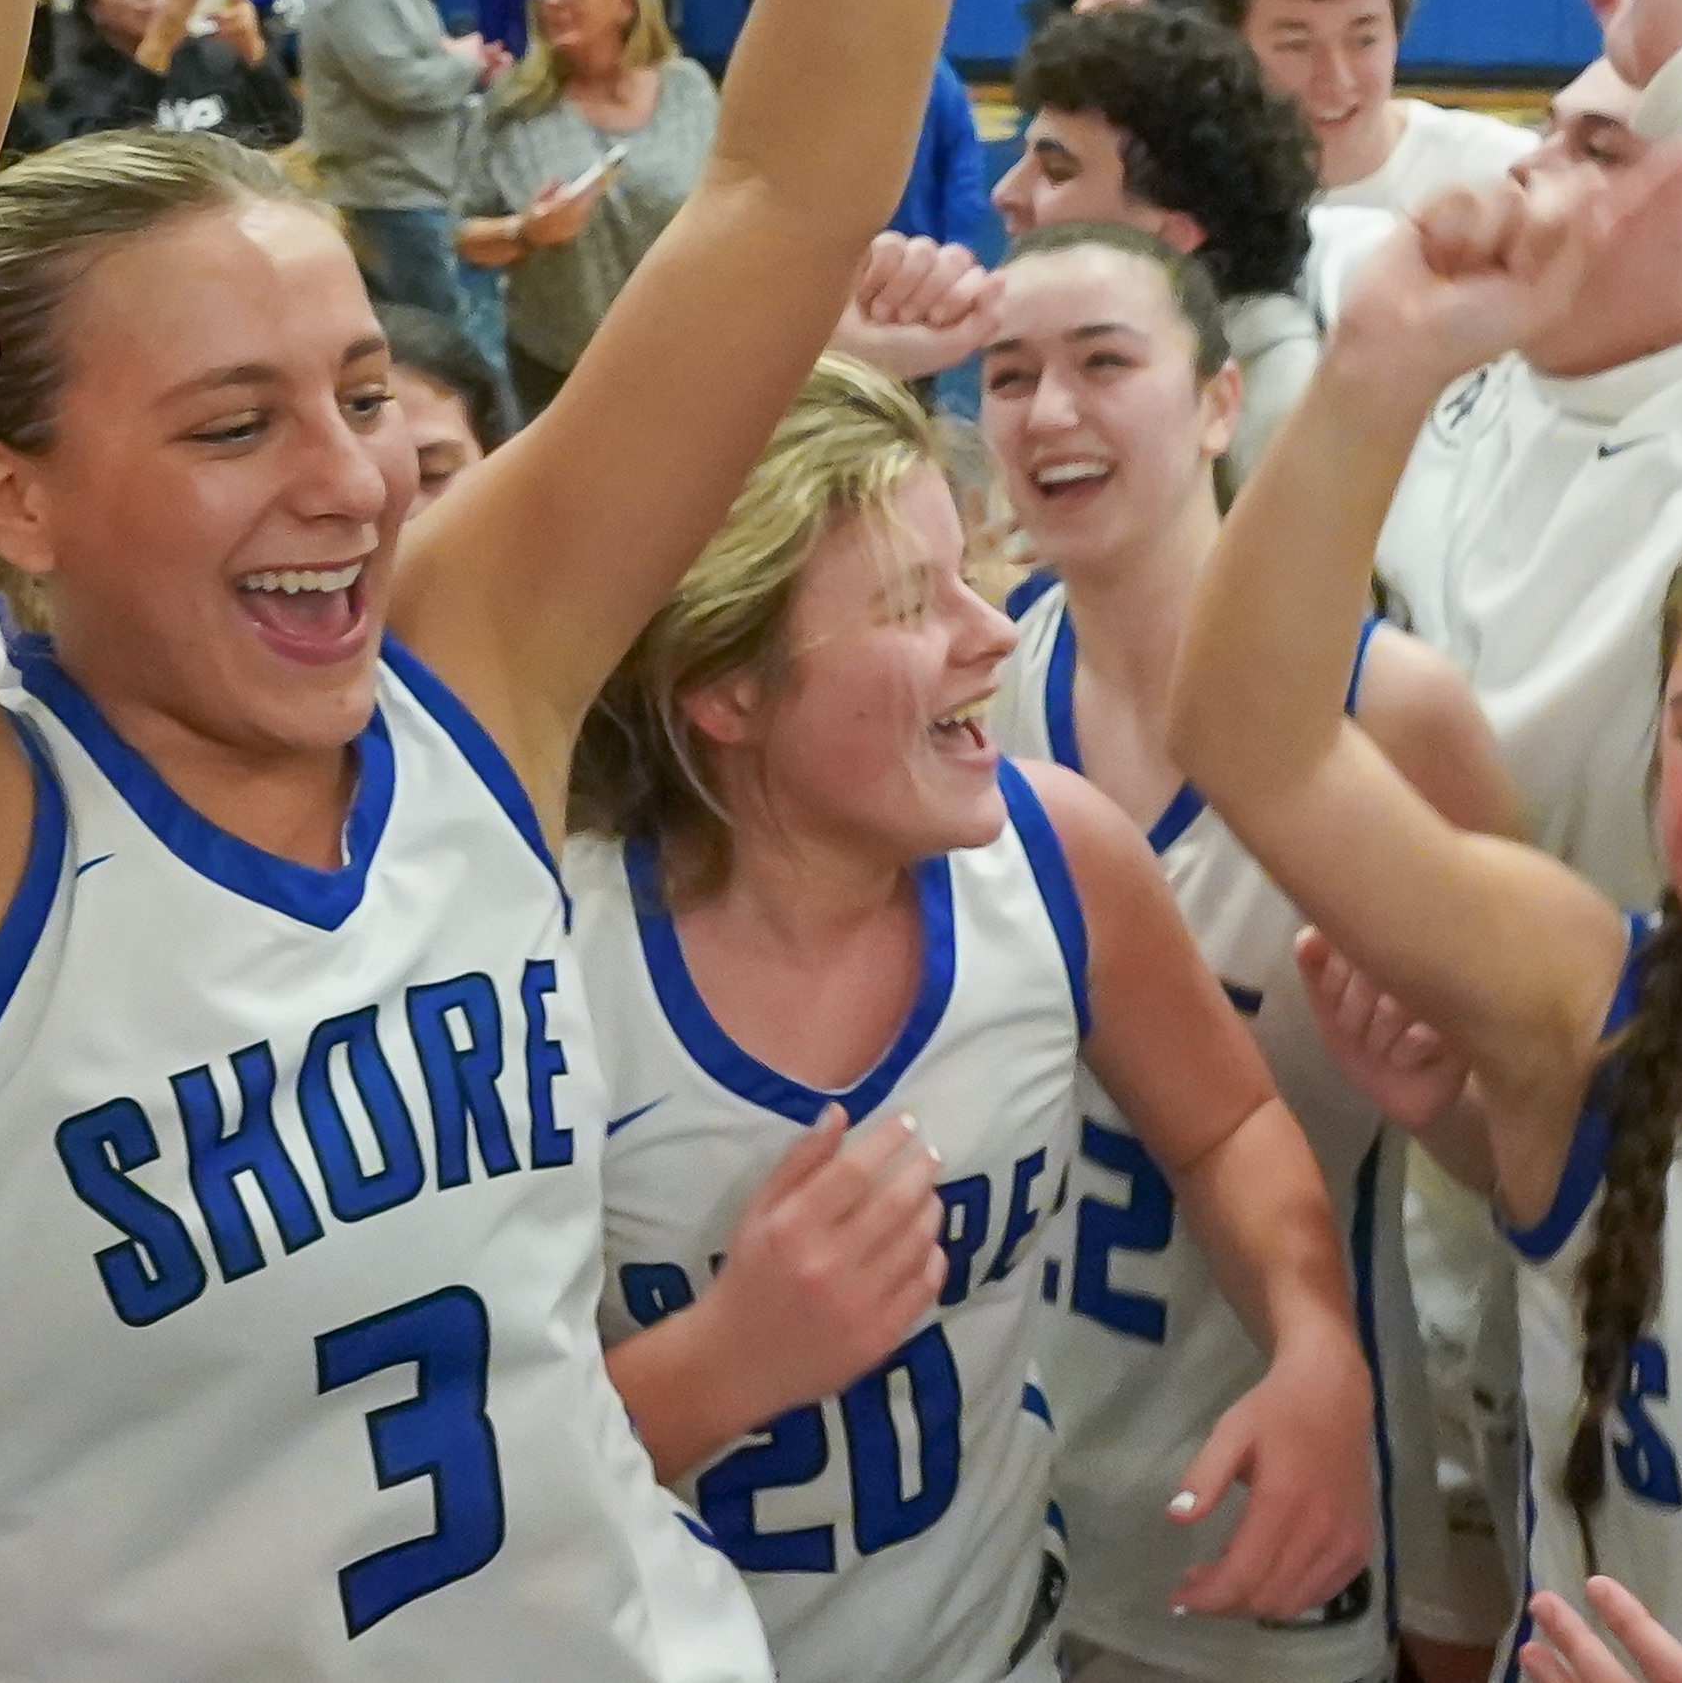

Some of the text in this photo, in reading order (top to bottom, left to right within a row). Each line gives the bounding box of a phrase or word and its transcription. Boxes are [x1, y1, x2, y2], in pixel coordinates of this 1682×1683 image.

[54, 958, 574, 1327] SHORE
[313, 1284, 507, 1640] 3
[694, 1322, 962, 1574] 20
